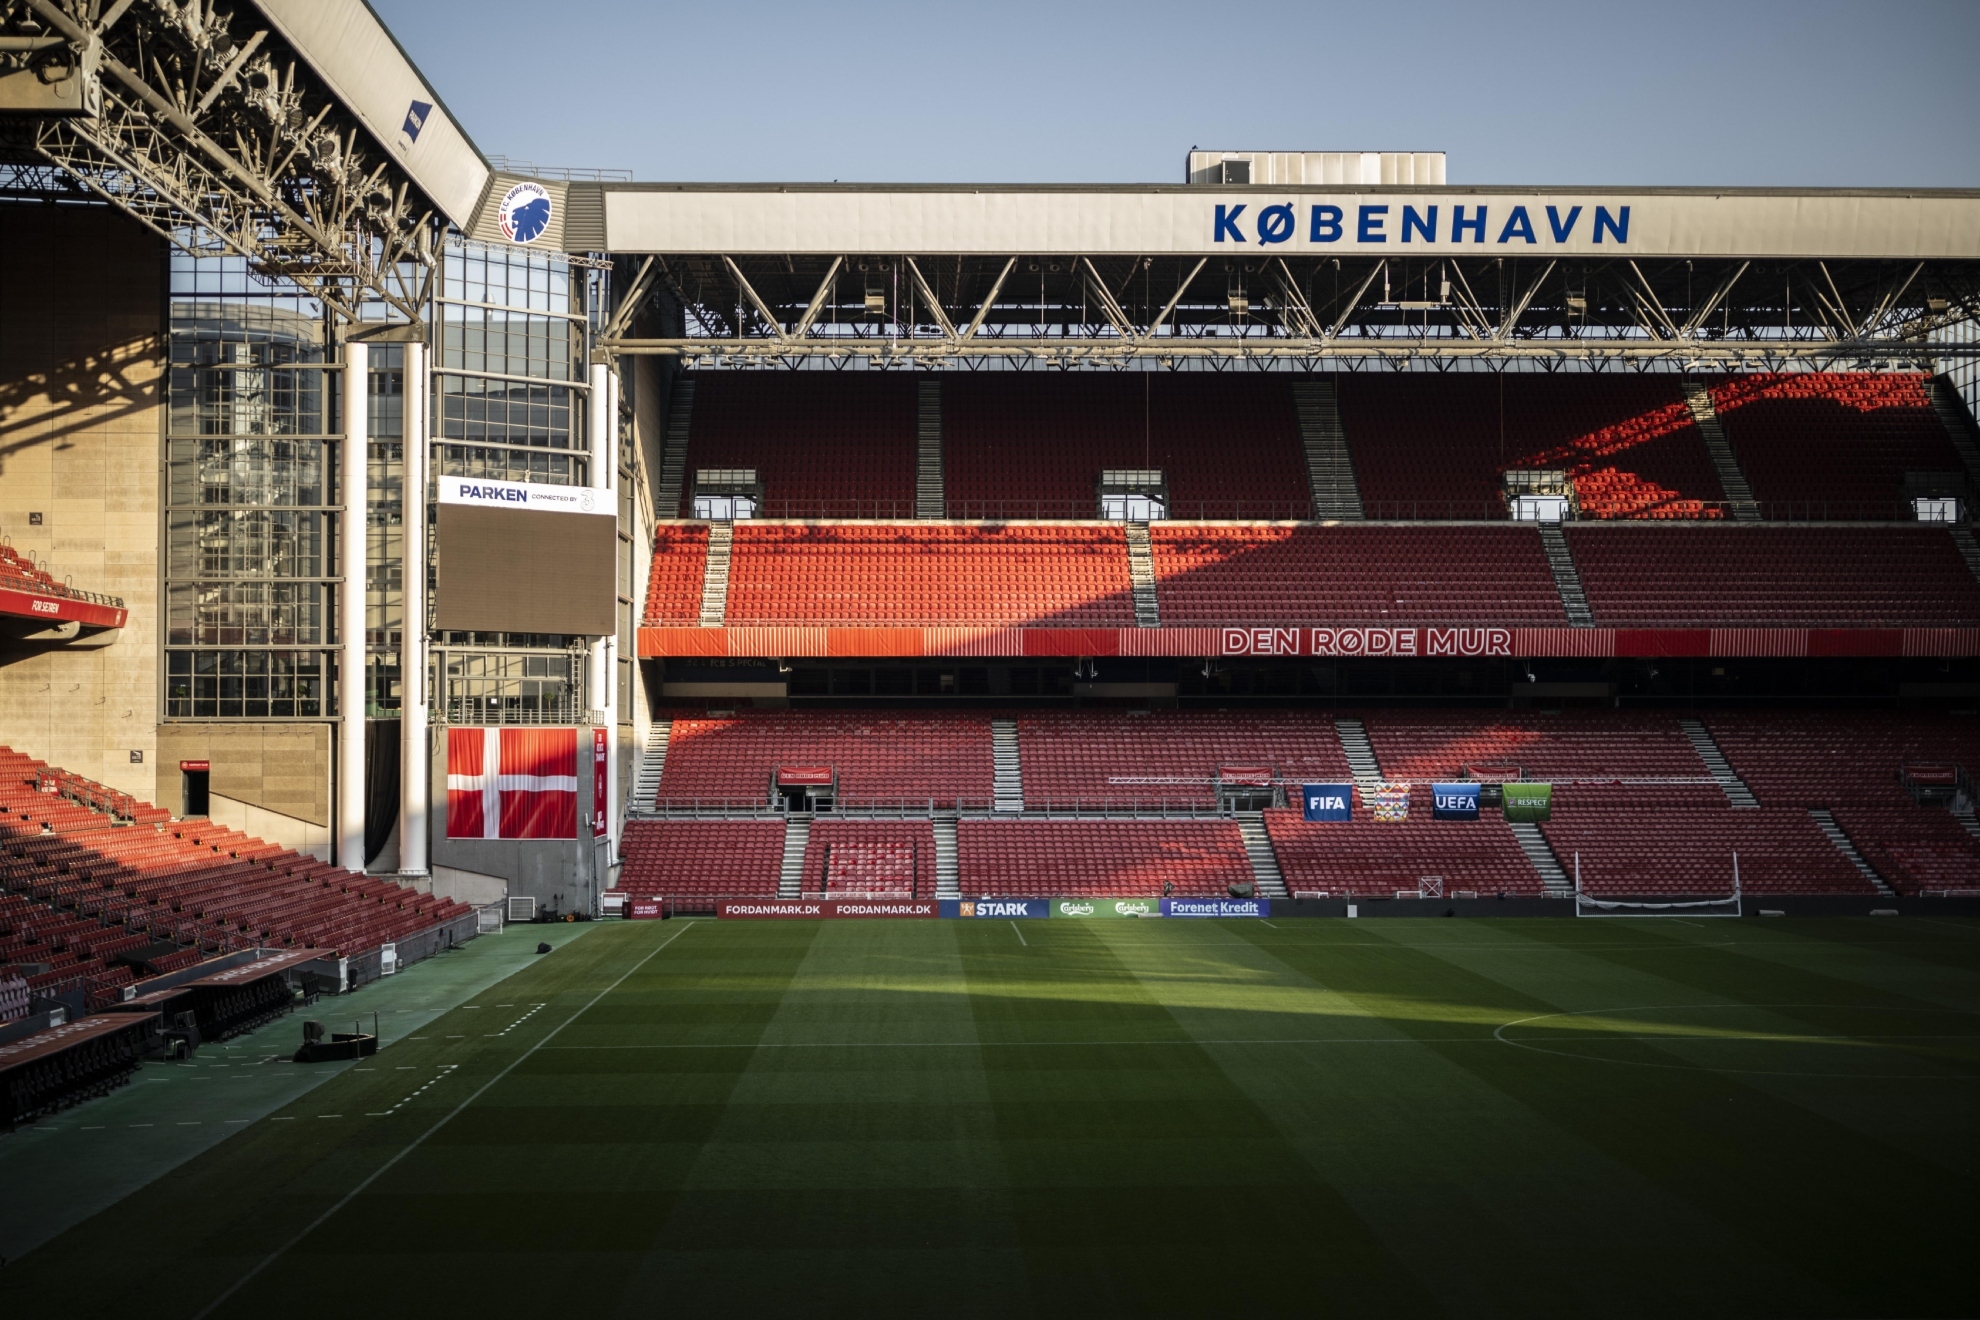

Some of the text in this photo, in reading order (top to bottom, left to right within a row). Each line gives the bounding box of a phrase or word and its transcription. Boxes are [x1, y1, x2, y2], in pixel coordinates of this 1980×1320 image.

[507, 184, 544, 200] KØBENHAVN
[1213, 202, 1631, 247] KØBENHAVN
[459, 484, 527, 502] PARKEN
[532, 493, 569, 502] CONNECTED
[1222, 628, 1511, 655] DEN RØDE MUR
[1310, 797, 1345, 809] FIFA
[1436, 797, 1476, 809] UEFA
[725, 905, 820, 914] FORDANMARK.DK
[836, 905, 931, 914] FORDANMARK.DK
[976, 903, 1028, 915] STARK
[1060, 902, 1094, 915] Carlsberg
[1115, 902, 1149, 915] Carlsberg
[1170, 901, 1258, 912] Forenet Kredit
